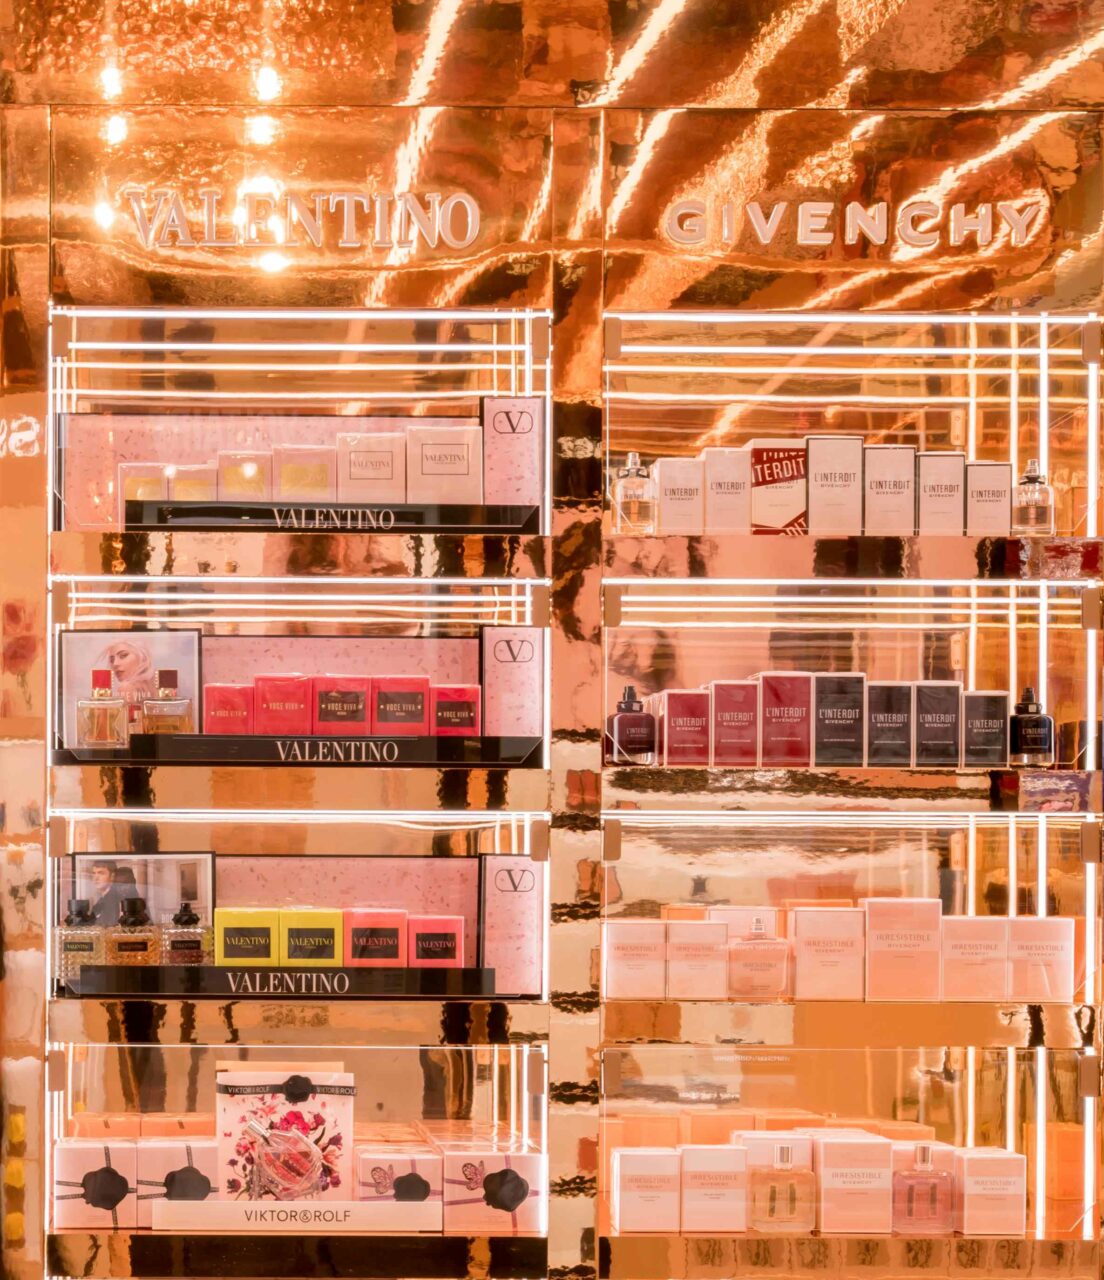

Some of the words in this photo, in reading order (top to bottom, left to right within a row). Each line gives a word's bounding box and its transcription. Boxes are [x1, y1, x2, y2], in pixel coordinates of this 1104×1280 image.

[125, 192, 481, 249] VALENTINO
[665, 201, 1040, 246] GIVENCHY
[424, 453, 466, 463] VALENTINA
[814, 472, 856, 482] L'INTERDIT
[710, 481, 746, 490] L'INTERDIT
[870, 480, 910, 490] L'INTERDIT
[924, 484, 960, 493] L'INTERDIT
[664, 488, 699, 497] L'INTERDIT
[971, 489, 1006, 498] L'INTERDIT
[272, 509, 394, 529] VALENTINO
[718, 712, 753, 721] L'INTERDIT
[766, 707, 806, 717] L'INTERDIT
[819, 708, 859, 719] L'INTERDIT
[671, 717, 706, 726] L'INTERDIT
[872, 713, 908, 722] L'INTERDIT
[920, 713, 956, 722] L'INTERDIT
[968, 719, 1004, 728] L'INTERDIT
[276, 741, 398, 762] VALENTINO
[226, 936, 269, 945] VALENTINO
[290, 937, 333, 946] VALENTINO
[353, 936, 397, 945] VALENTINO
[876, 933, 931, 941] IRRESISTIBLE
[417, 940, 455, 949] VALENTINO
[226, 972, 349, 993] VALENTINO
[244, 1209, 351, 1223] VIKTOR&ROLF
